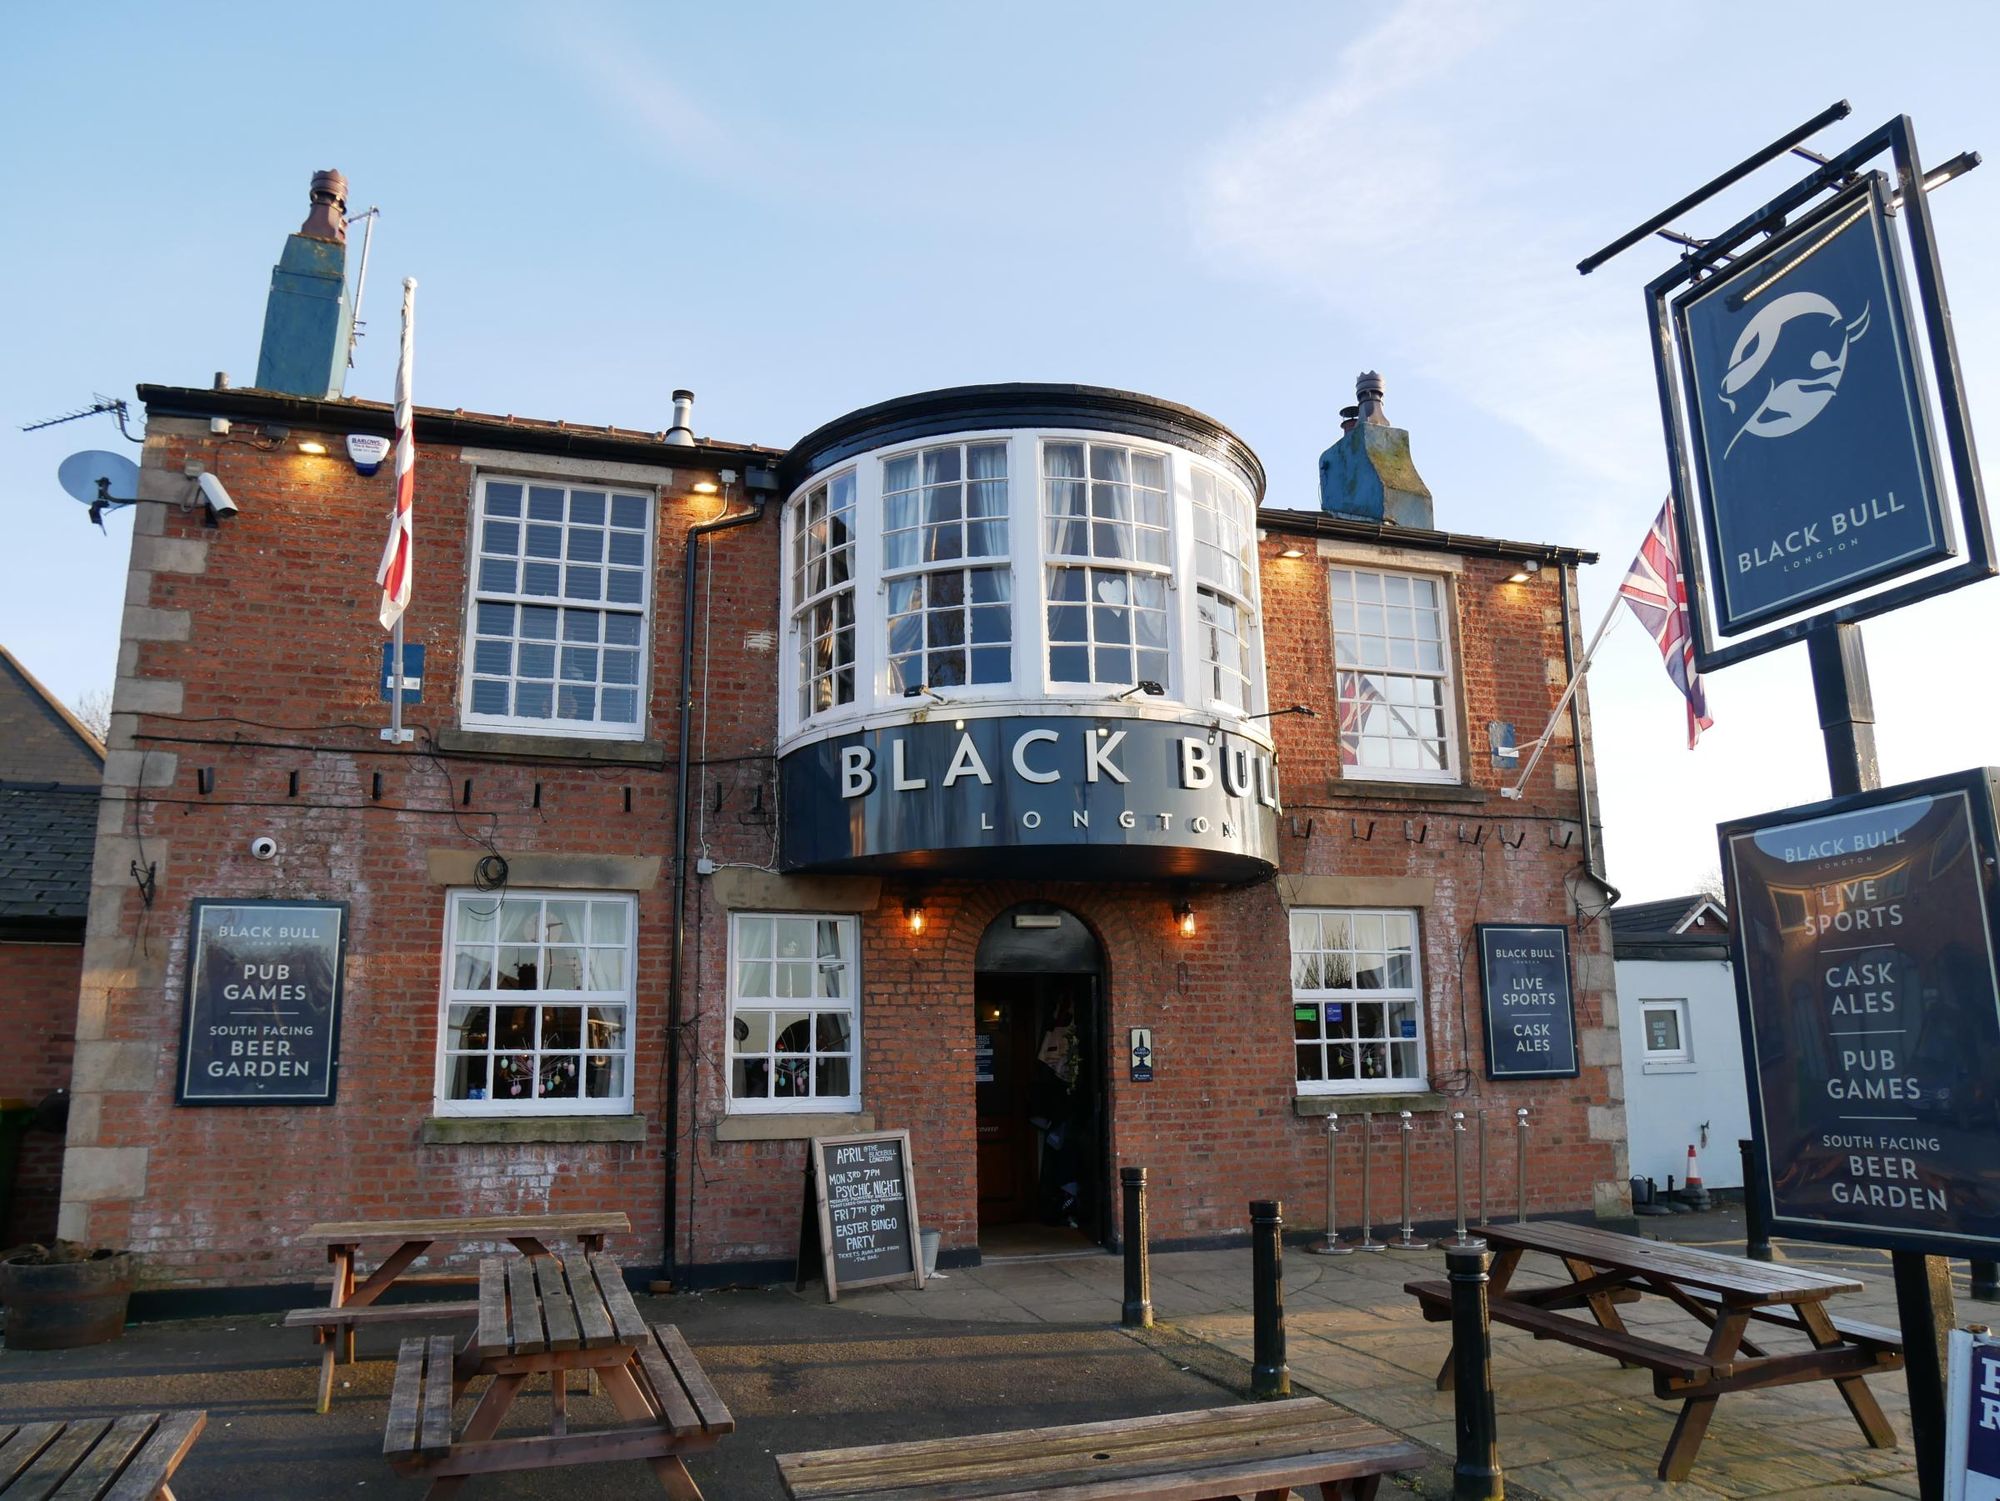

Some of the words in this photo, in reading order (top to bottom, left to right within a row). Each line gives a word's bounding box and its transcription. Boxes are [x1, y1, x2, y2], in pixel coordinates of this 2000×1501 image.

[1738, 522, 1821, 574] BLACK
[1831, 491, 1905, 536] BULL
[1784, 538, 1858, 572] LONGTON
[841, 728, 1131, 799] BLACK
[1182, 736, 1282, 816] BUL
[981, 809, 1238, 838] LONGTON
[1785, 838, 1845, 863] BLACK
[1853, 828, 1906, 851] BULL
[1818, 855, 1872, 871] LONGTON
[1820, 880, 1877, 907] LIVE
[1804, 904, 1903, 936] SPORTS
[219, 925, 273, 938] BLACK
[279, 927, 320, 938] BULL
[1495, 949, 1528, 958] BLACK
[1530, 949, 1555, 958] BULL
[243, 964, 290, 980] PUB
[1825, 962, 1895, 988] CASK
[223, 984, 306, 1001] GAMES
[1512, 977, 1543, 990] LIVE
[1502, 993, 1556, 1006] SPORTS
[1831, 991, 1895, 1016] ALES
[210, 1025, 257, 1036] SOUTH
[263, 1026, 314, 1036] FACING
[1513, 1024, 1551, 1037] CASK
[231, 1040, 290, 1057] BEER
[1516, 1039, 1550, 1052] ALES
[207, 1061, 310, 1077] GARDEN
[1843, 1049, 1896, 1071] PUB
[1827, 1077, 1921, 1100] GAMES
[1823, 1134, 1873, 1149] SOUTH
[1880, 1136, 1940, 1151] FACING
[837, 1147, 865, 1165] APRIL
[1849, 1155, 1919, 1180] BEER
[828, 1172, 846, 1186] MON
[846, 1170, 861, 1183] 3RD
[863, 1168, 880, 1181] 7PM
[835, 1182, 872, 1199] PSYCHIC
[873, 1179, 900, 1196] NIGHT
[1831, 1182, 1947, 1212] GARDEN
[834, 1208, 849, 1222] FRI
[850, 1205, 867, 1219] 7TH
[870, 1203, 886, 1217] 8PM
[836, 1221, 869, 1237] EASTER
[871, 1217, 898, 1232] BINGO
[846, 1234, 875, 1251] PARTY
